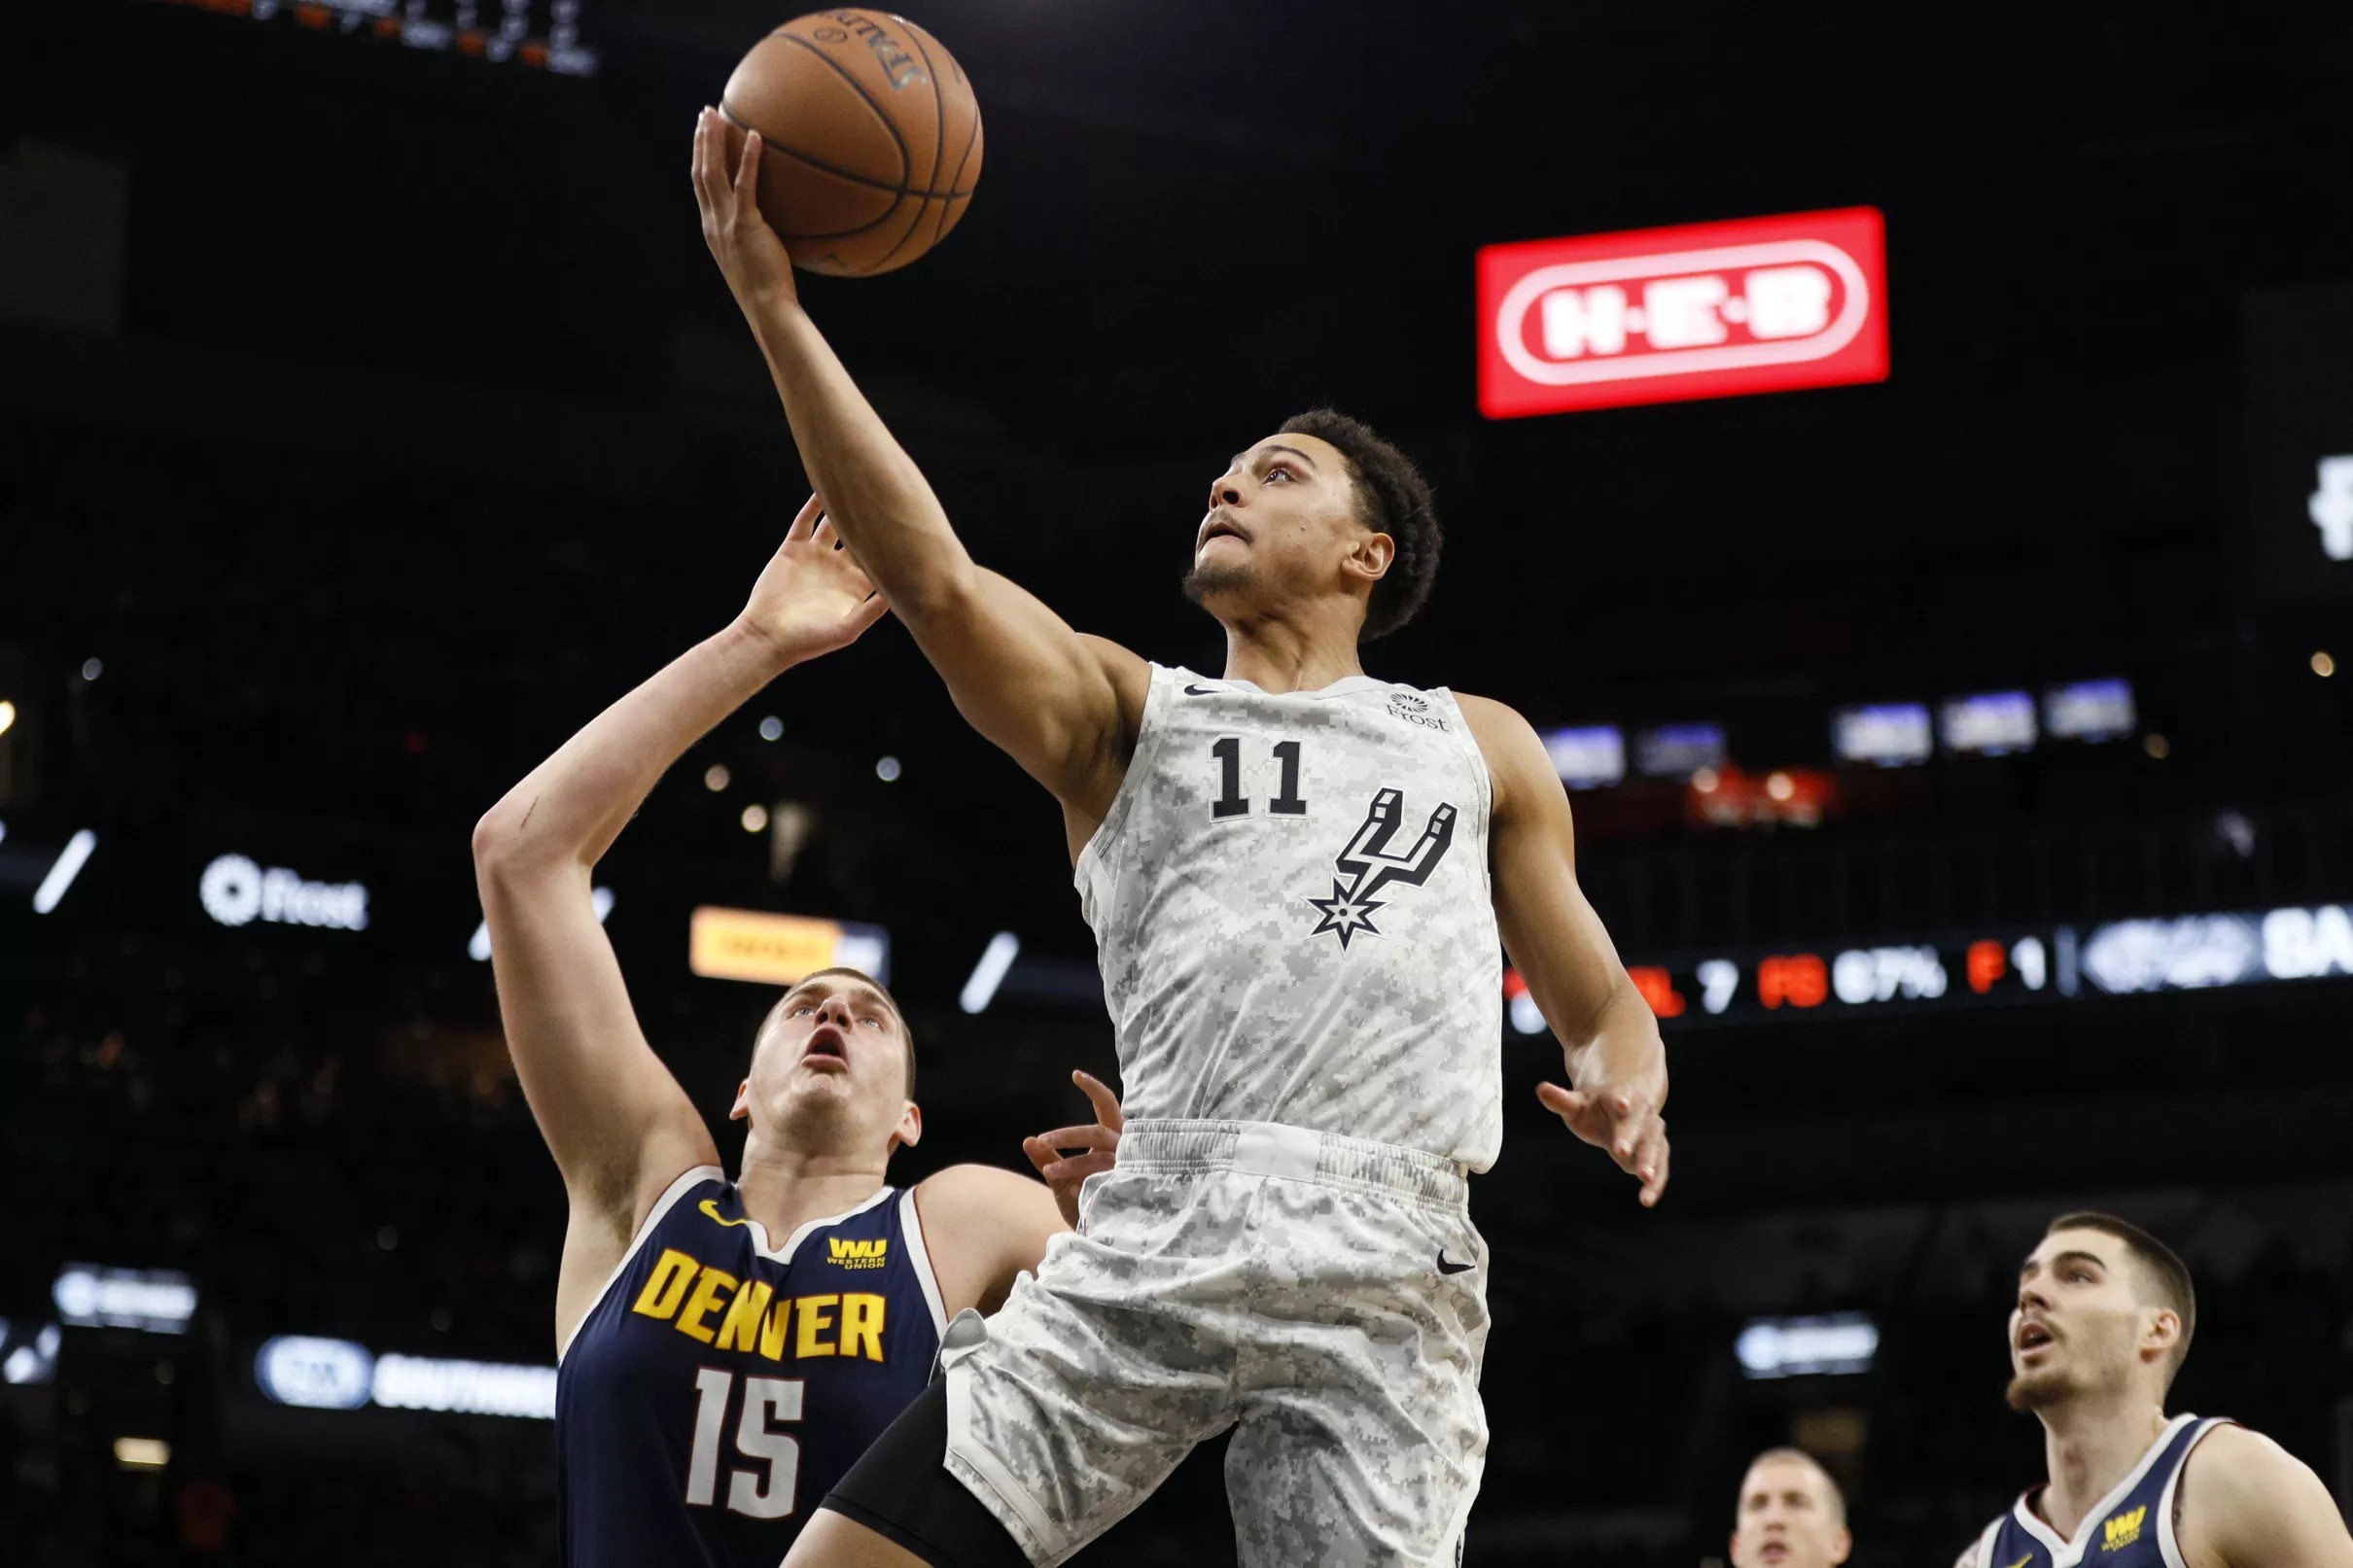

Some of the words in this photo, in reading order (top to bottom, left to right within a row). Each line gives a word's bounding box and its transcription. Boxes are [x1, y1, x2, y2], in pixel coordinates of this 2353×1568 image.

[1385, 704, 1450, 733] Frost
[1209, 734, 1310, 823] 11
[826, 1256, 886, 1266] WESTERN
[829, 1237, 887, 1259] WU
[844, 1262, 886, 1271] UNION
[632, 1247, 887, 1363] DENVER
[685, 1365, 805, 1521] 15
